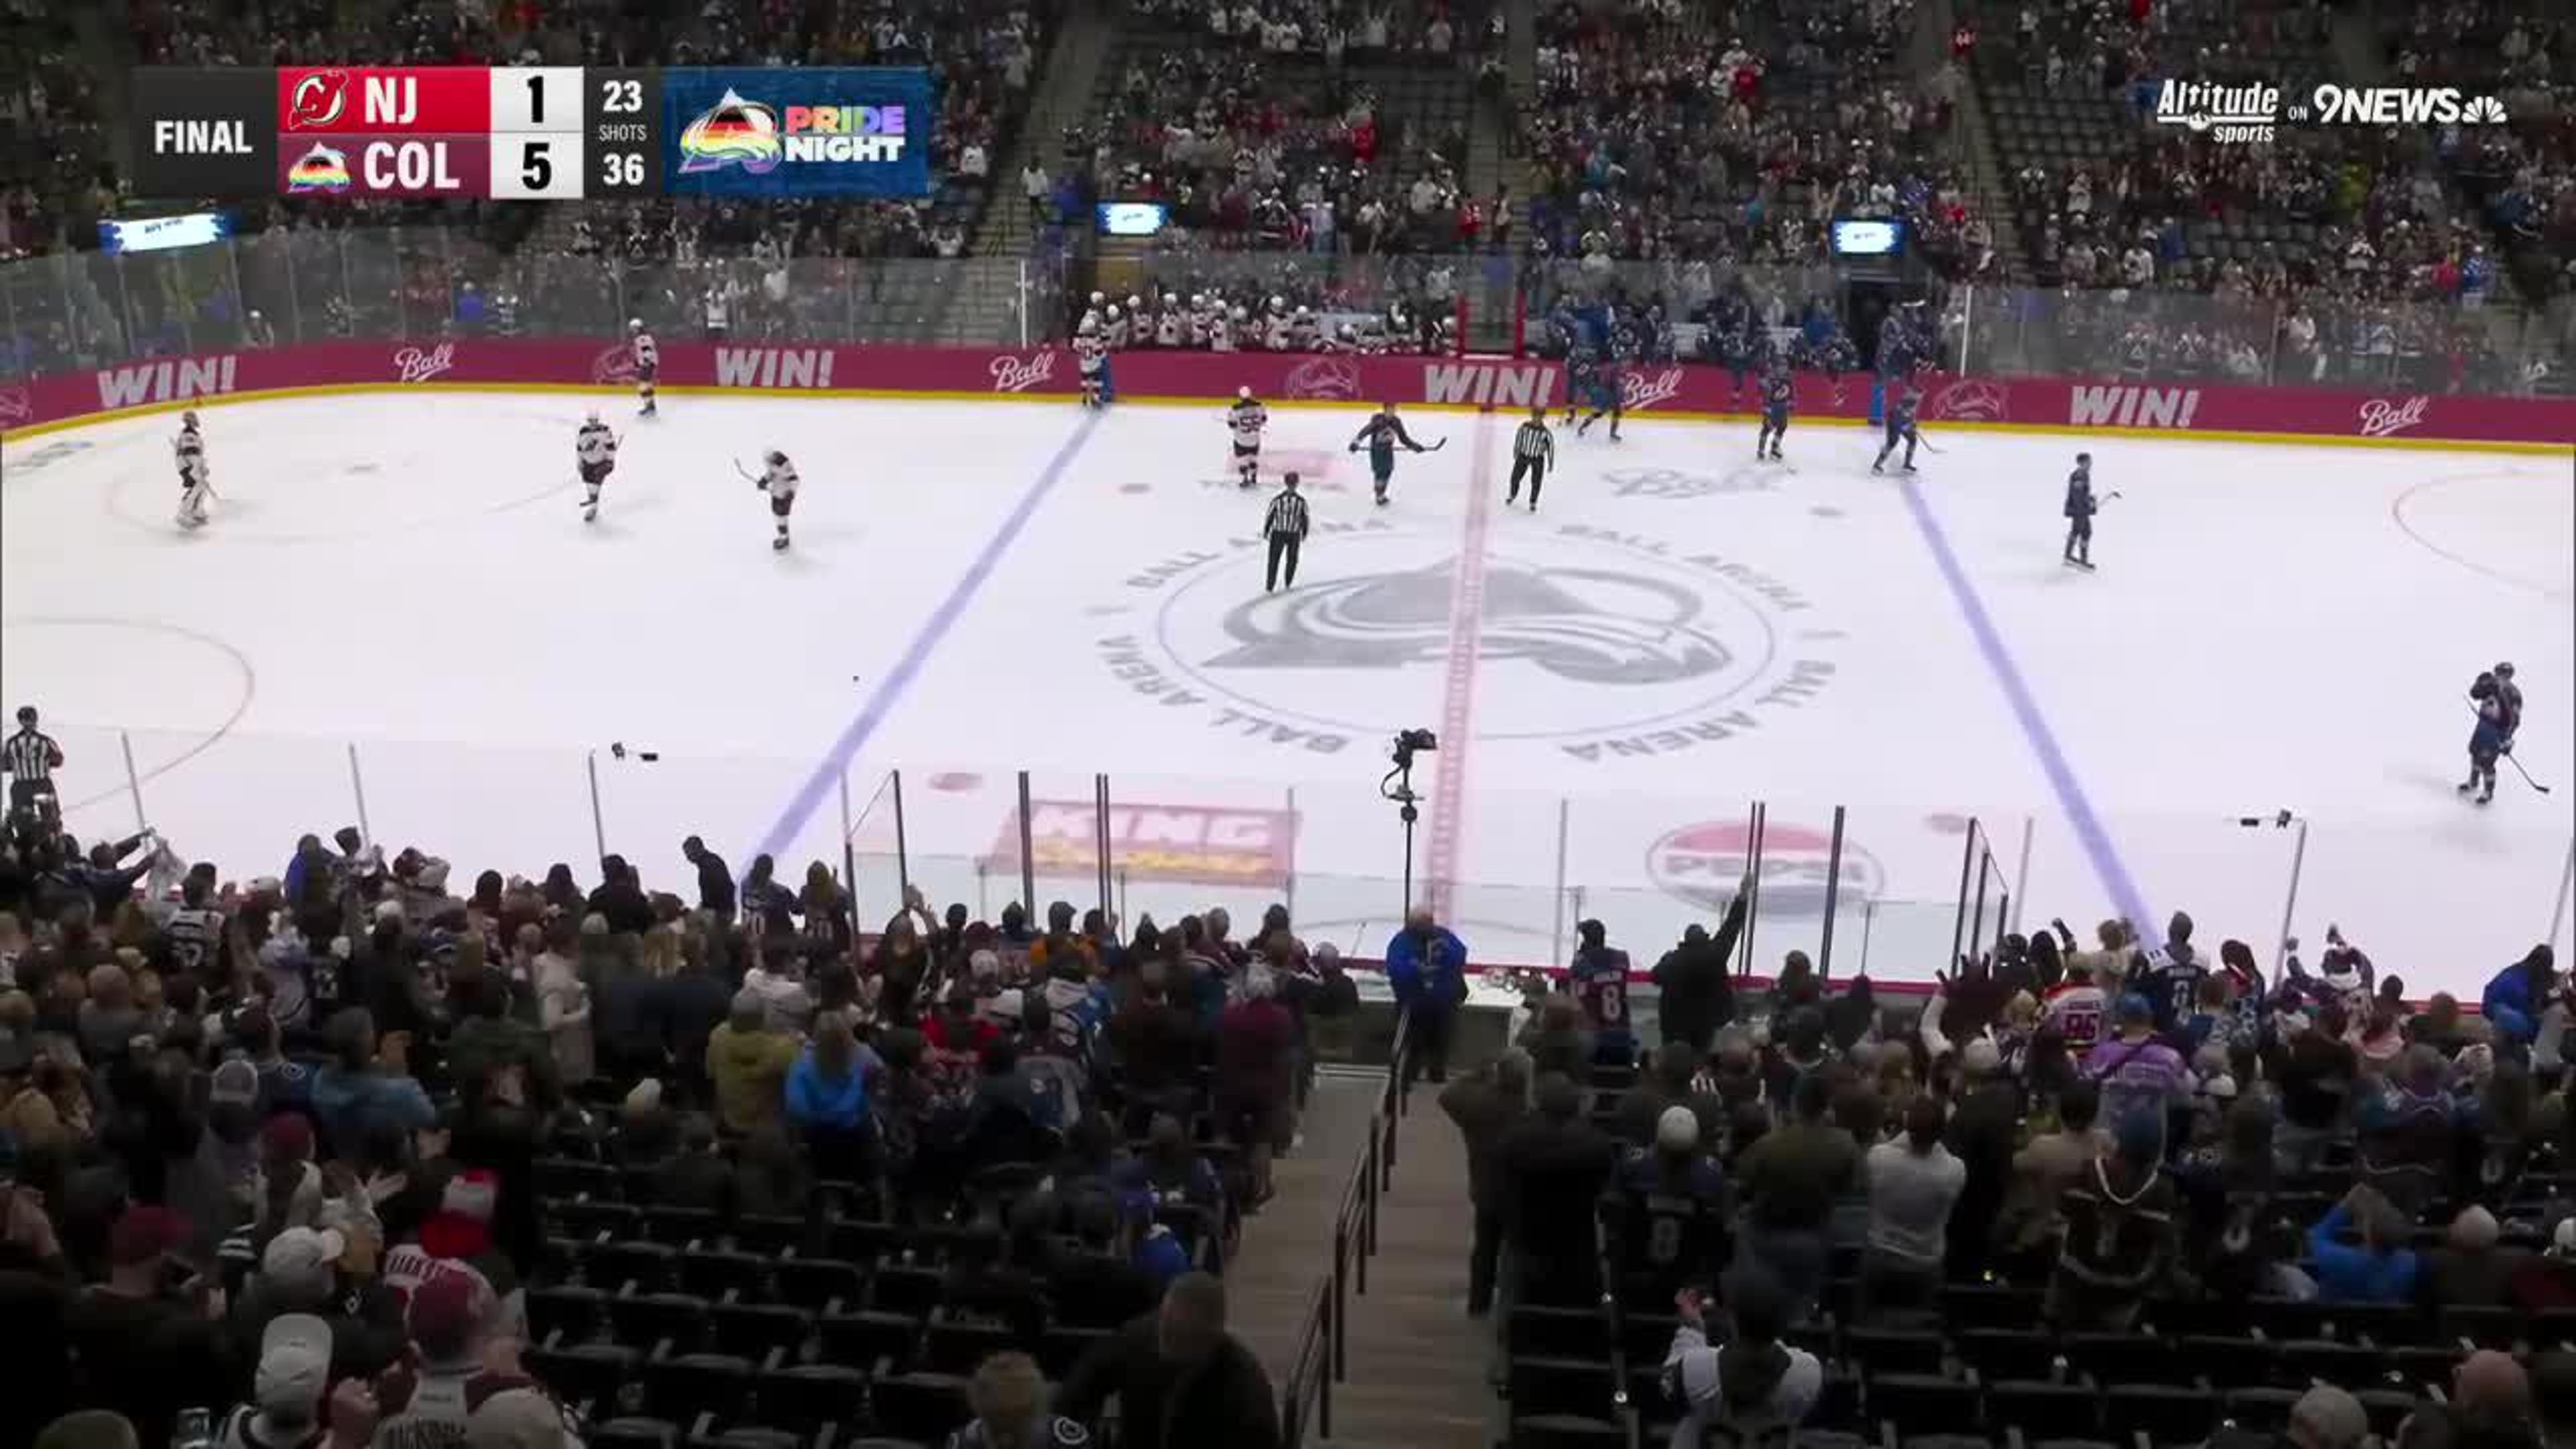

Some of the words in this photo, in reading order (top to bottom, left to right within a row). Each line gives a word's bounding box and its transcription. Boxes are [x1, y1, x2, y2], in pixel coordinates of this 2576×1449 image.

[97, 355, 237, 409] WIN!
[395, 343, 455, 383] Ball
[714, 348, 835, 388] WIN!
[990, 352, 1057, 392] Ball
[1424, 364, 1556, 406] WIN!
[1619, 369, 1684, 409] Ball
[2069, 384, 2200, 428] WIN!
[2359, 396, 2428, 436] Ball
